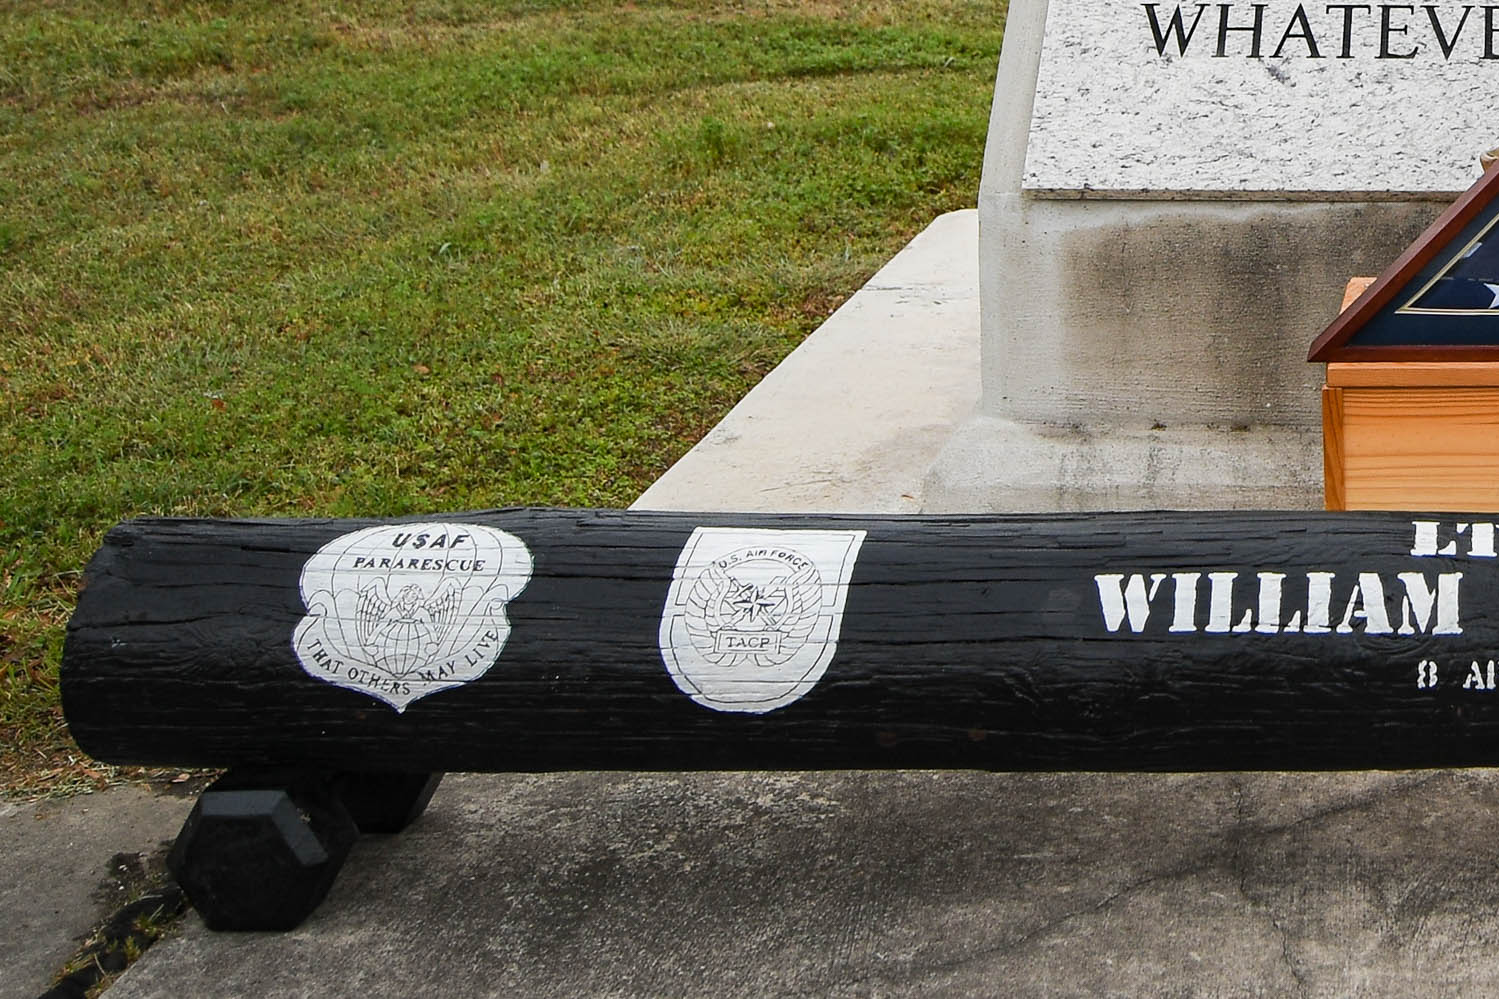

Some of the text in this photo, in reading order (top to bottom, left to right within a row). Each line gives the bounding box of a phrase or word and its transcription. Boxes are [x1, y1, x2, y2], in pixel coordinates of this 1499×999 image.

[392, 533, 471, 549] USAF
[352, 557, 487, 572] PARARESCUE
[770, 549, 809, 570] FORCE
[1095, 571, 1463, 637] WILLIAM
[725, 636, 770, 648] TACP
[306, 630, 499, 696] THAT OTHERS MAY LIVE
